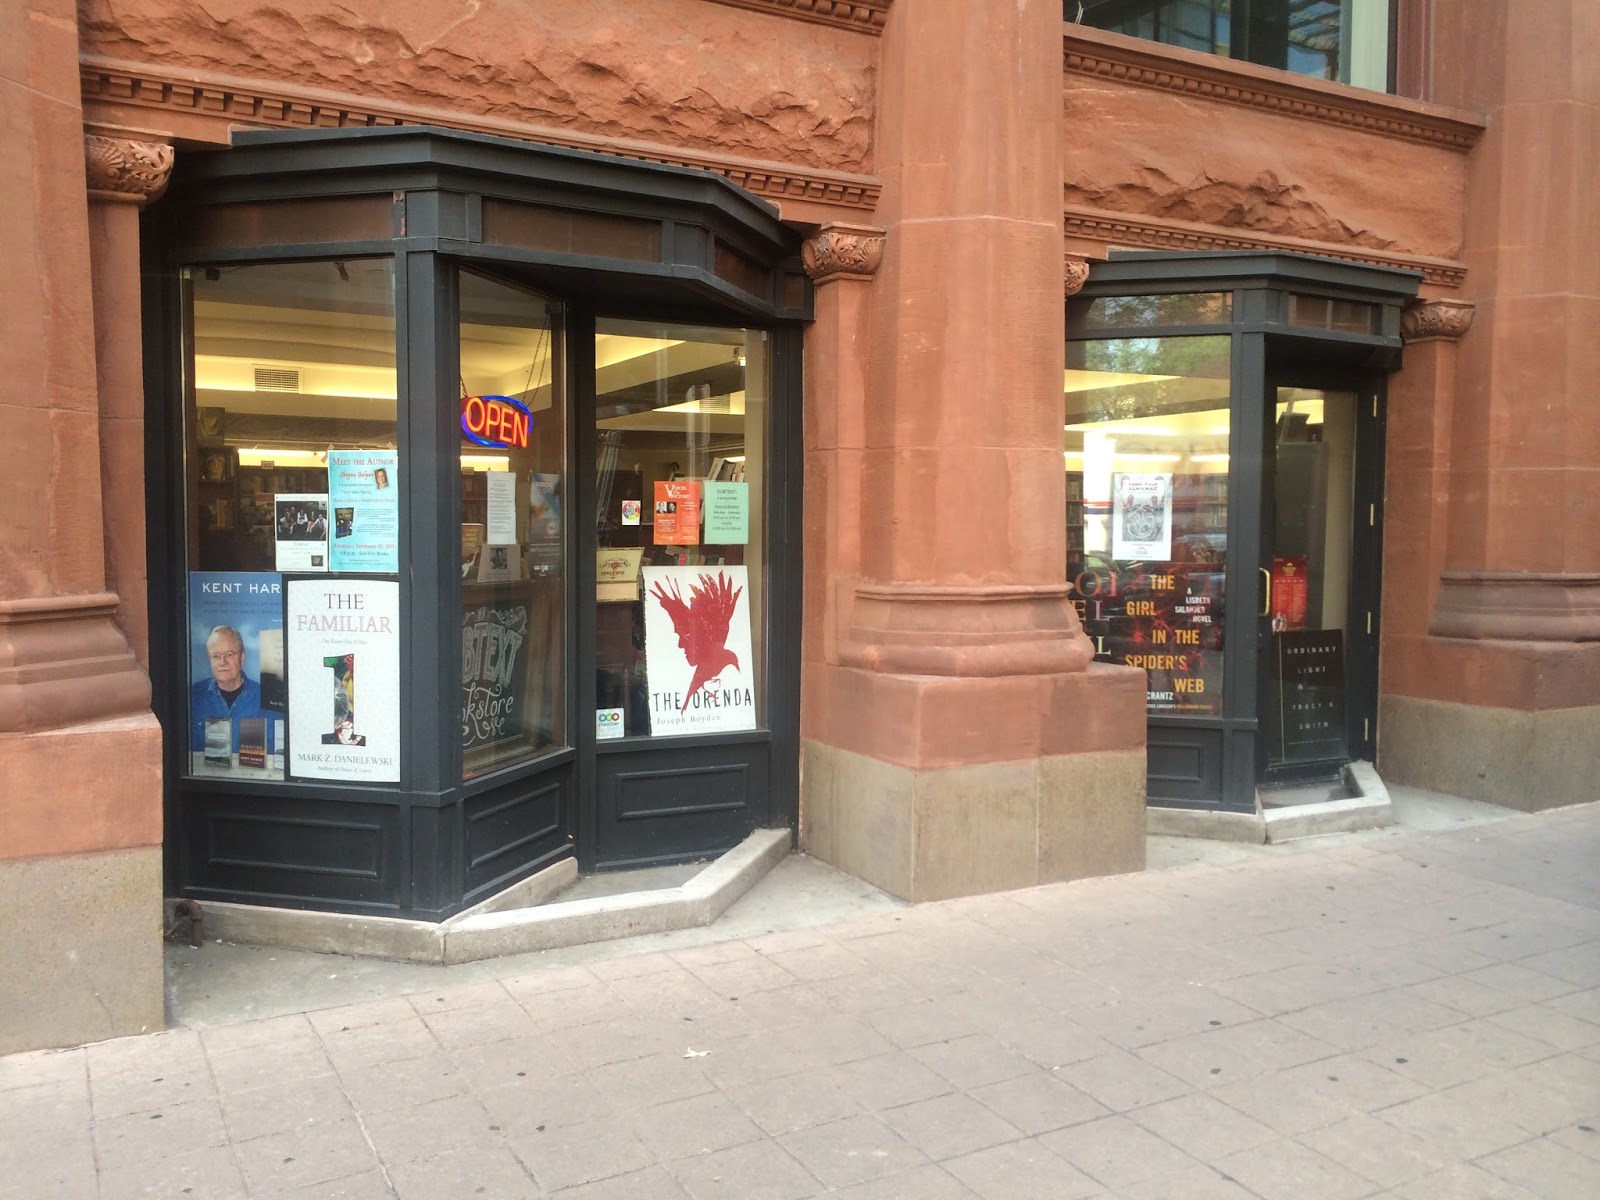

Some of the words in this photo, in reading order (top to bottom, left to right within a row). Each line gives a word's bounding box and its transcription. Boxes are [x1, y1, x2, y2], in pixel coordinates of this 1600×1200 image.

[465, 397, 528, 448] OPEN
[332, 458, 350, 466] MEET
[367, 458, 394, 466] AUTHOR
[202, 582, 242, 593] KENT
[249, 583, 280, 594] HAR
[1150, 575, 1175, 590] THE
[324, 593, 364, 609] THE
[1126, 601, 1157, 616] GIRL
[296, 614, 392, 634] FAMILIAR
[1152, 630, 1166, 644] IN
[1175, 630, 1200, 644] THE
[1287, 646, 1337, 654] ORDINARY
[1125, 655, 1188, 670] SPIDER'S
[1174, 678, 1204, 693] WEB
[321, 654, 366, 746] 1
[653, 692, 682, 712] THE
[693, 688, 752, 709] ORENDA
[656, 715, 686, 725] Joseph
[690, 714, 721, 723] Boyden
[298, 753, 323, 762] MARK
[324, 754, 333, 763] Z.
[334, 755, 392, 765] DANIELEWSKI
